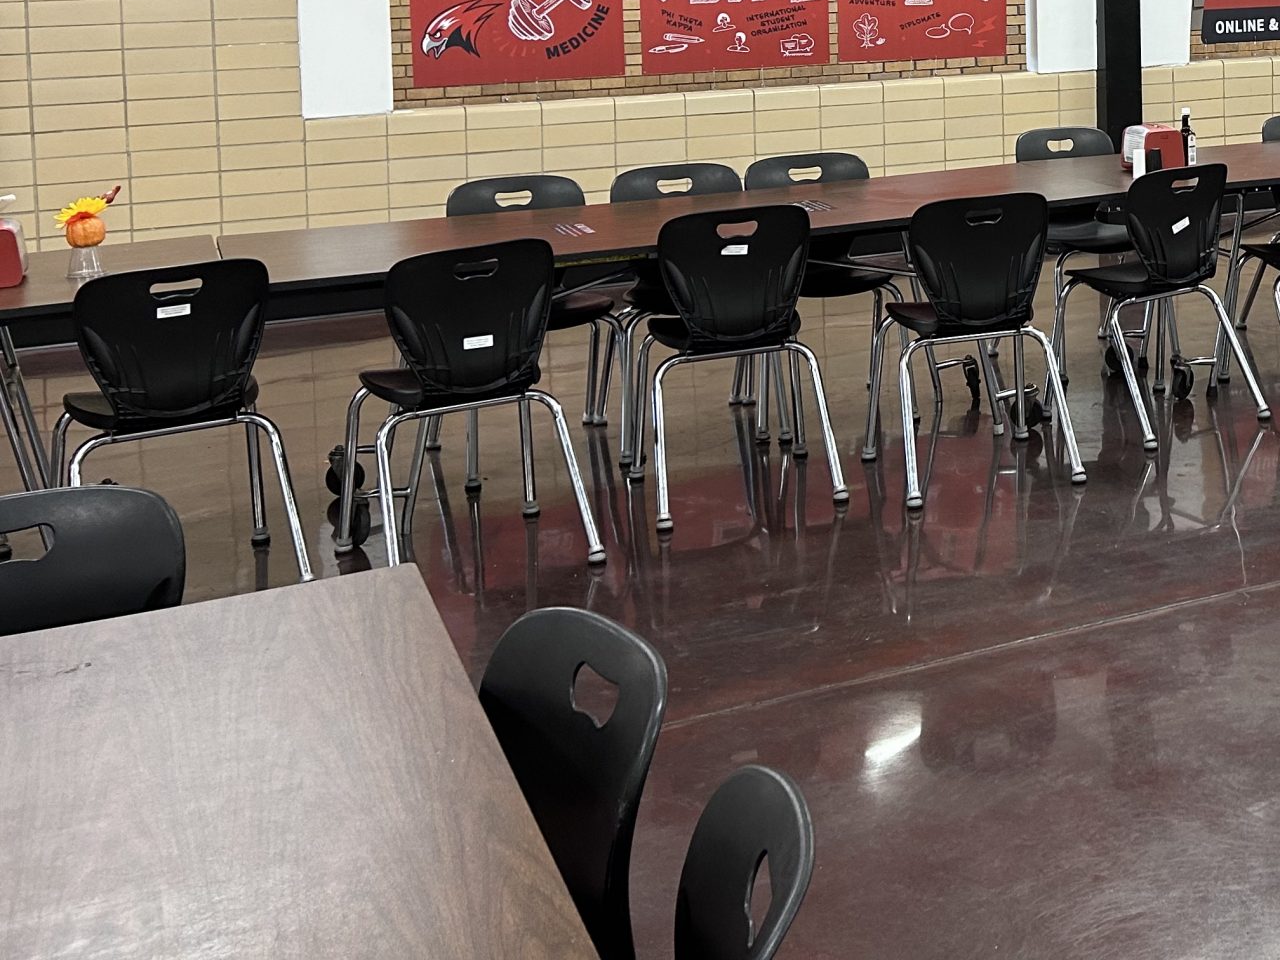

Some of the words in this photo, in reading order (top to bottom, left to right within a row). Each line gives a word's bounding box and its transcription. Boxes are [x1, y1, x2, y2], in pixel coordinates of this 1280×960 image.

[661, 9, 675, 20] PHI
[678, 14, 703, 27] THETA
[746, 5, 806, 22] INTERNATIONAL
[760, 15, 795, 27] STUDENT
[545, 3, 610, 60] MEDICINE
[666, 20, 693, 32] KAPPA
[751, 21, 808, 37] ORGANIZATION
[1215, 18, 1265, 34] ONLINE
[1268, 17, 1279, 31] &
